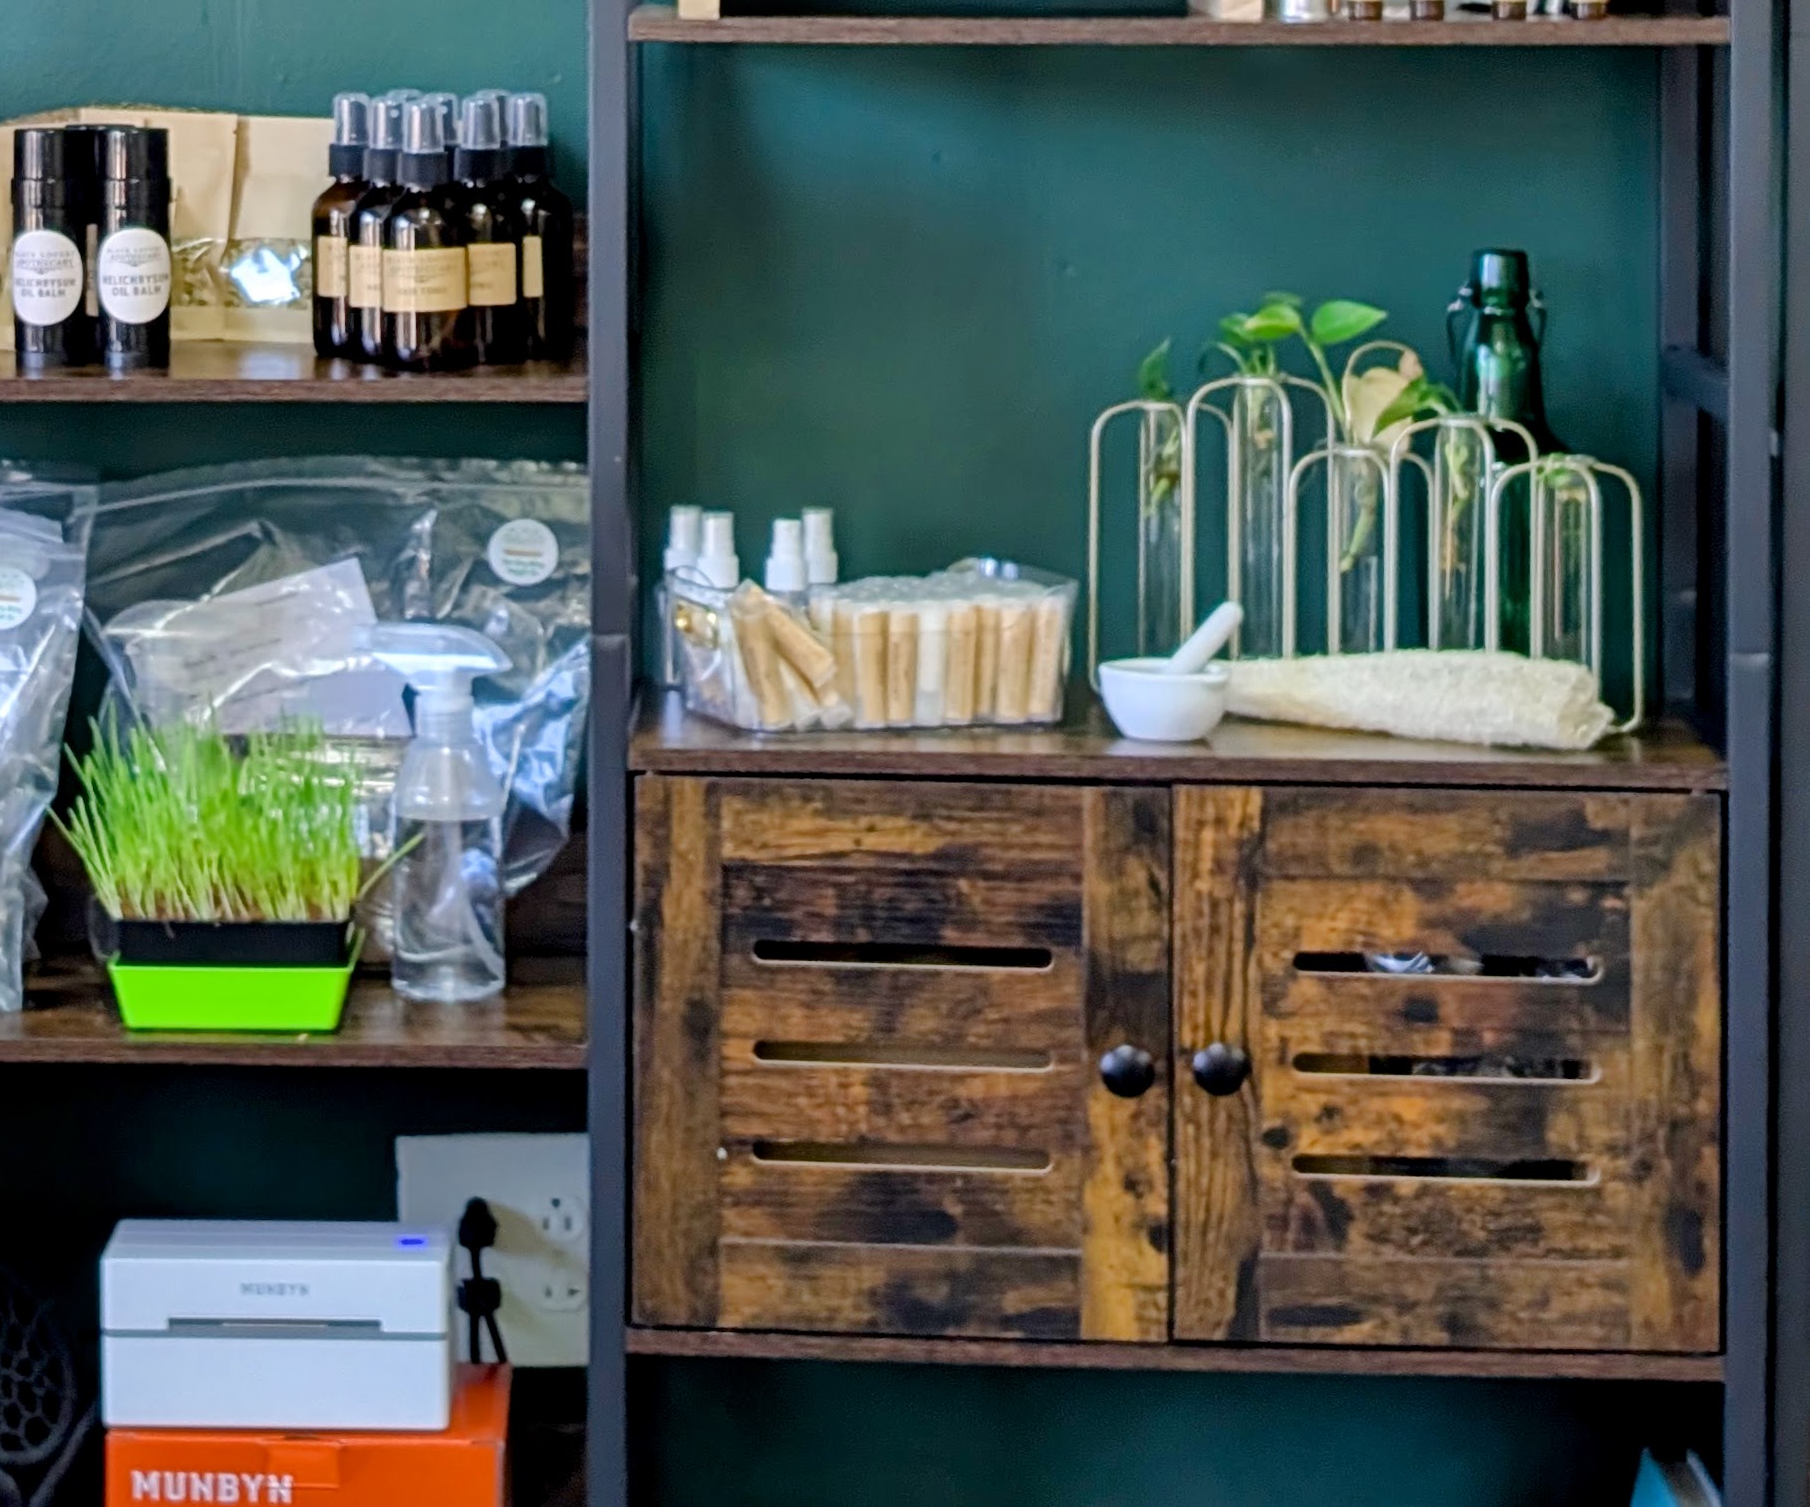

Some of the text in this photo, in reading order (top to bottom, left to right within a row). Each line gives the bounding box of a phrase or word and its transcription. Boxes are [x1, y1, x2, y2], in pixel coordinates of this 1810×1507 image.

[21, 288, 67, 299] OIL BALM
[112, 285, 162, 297] OIL BALM
[240, 1281, 310, 1297] MUNBYN
[130, 1469, 296, 1505] MUNBYN
